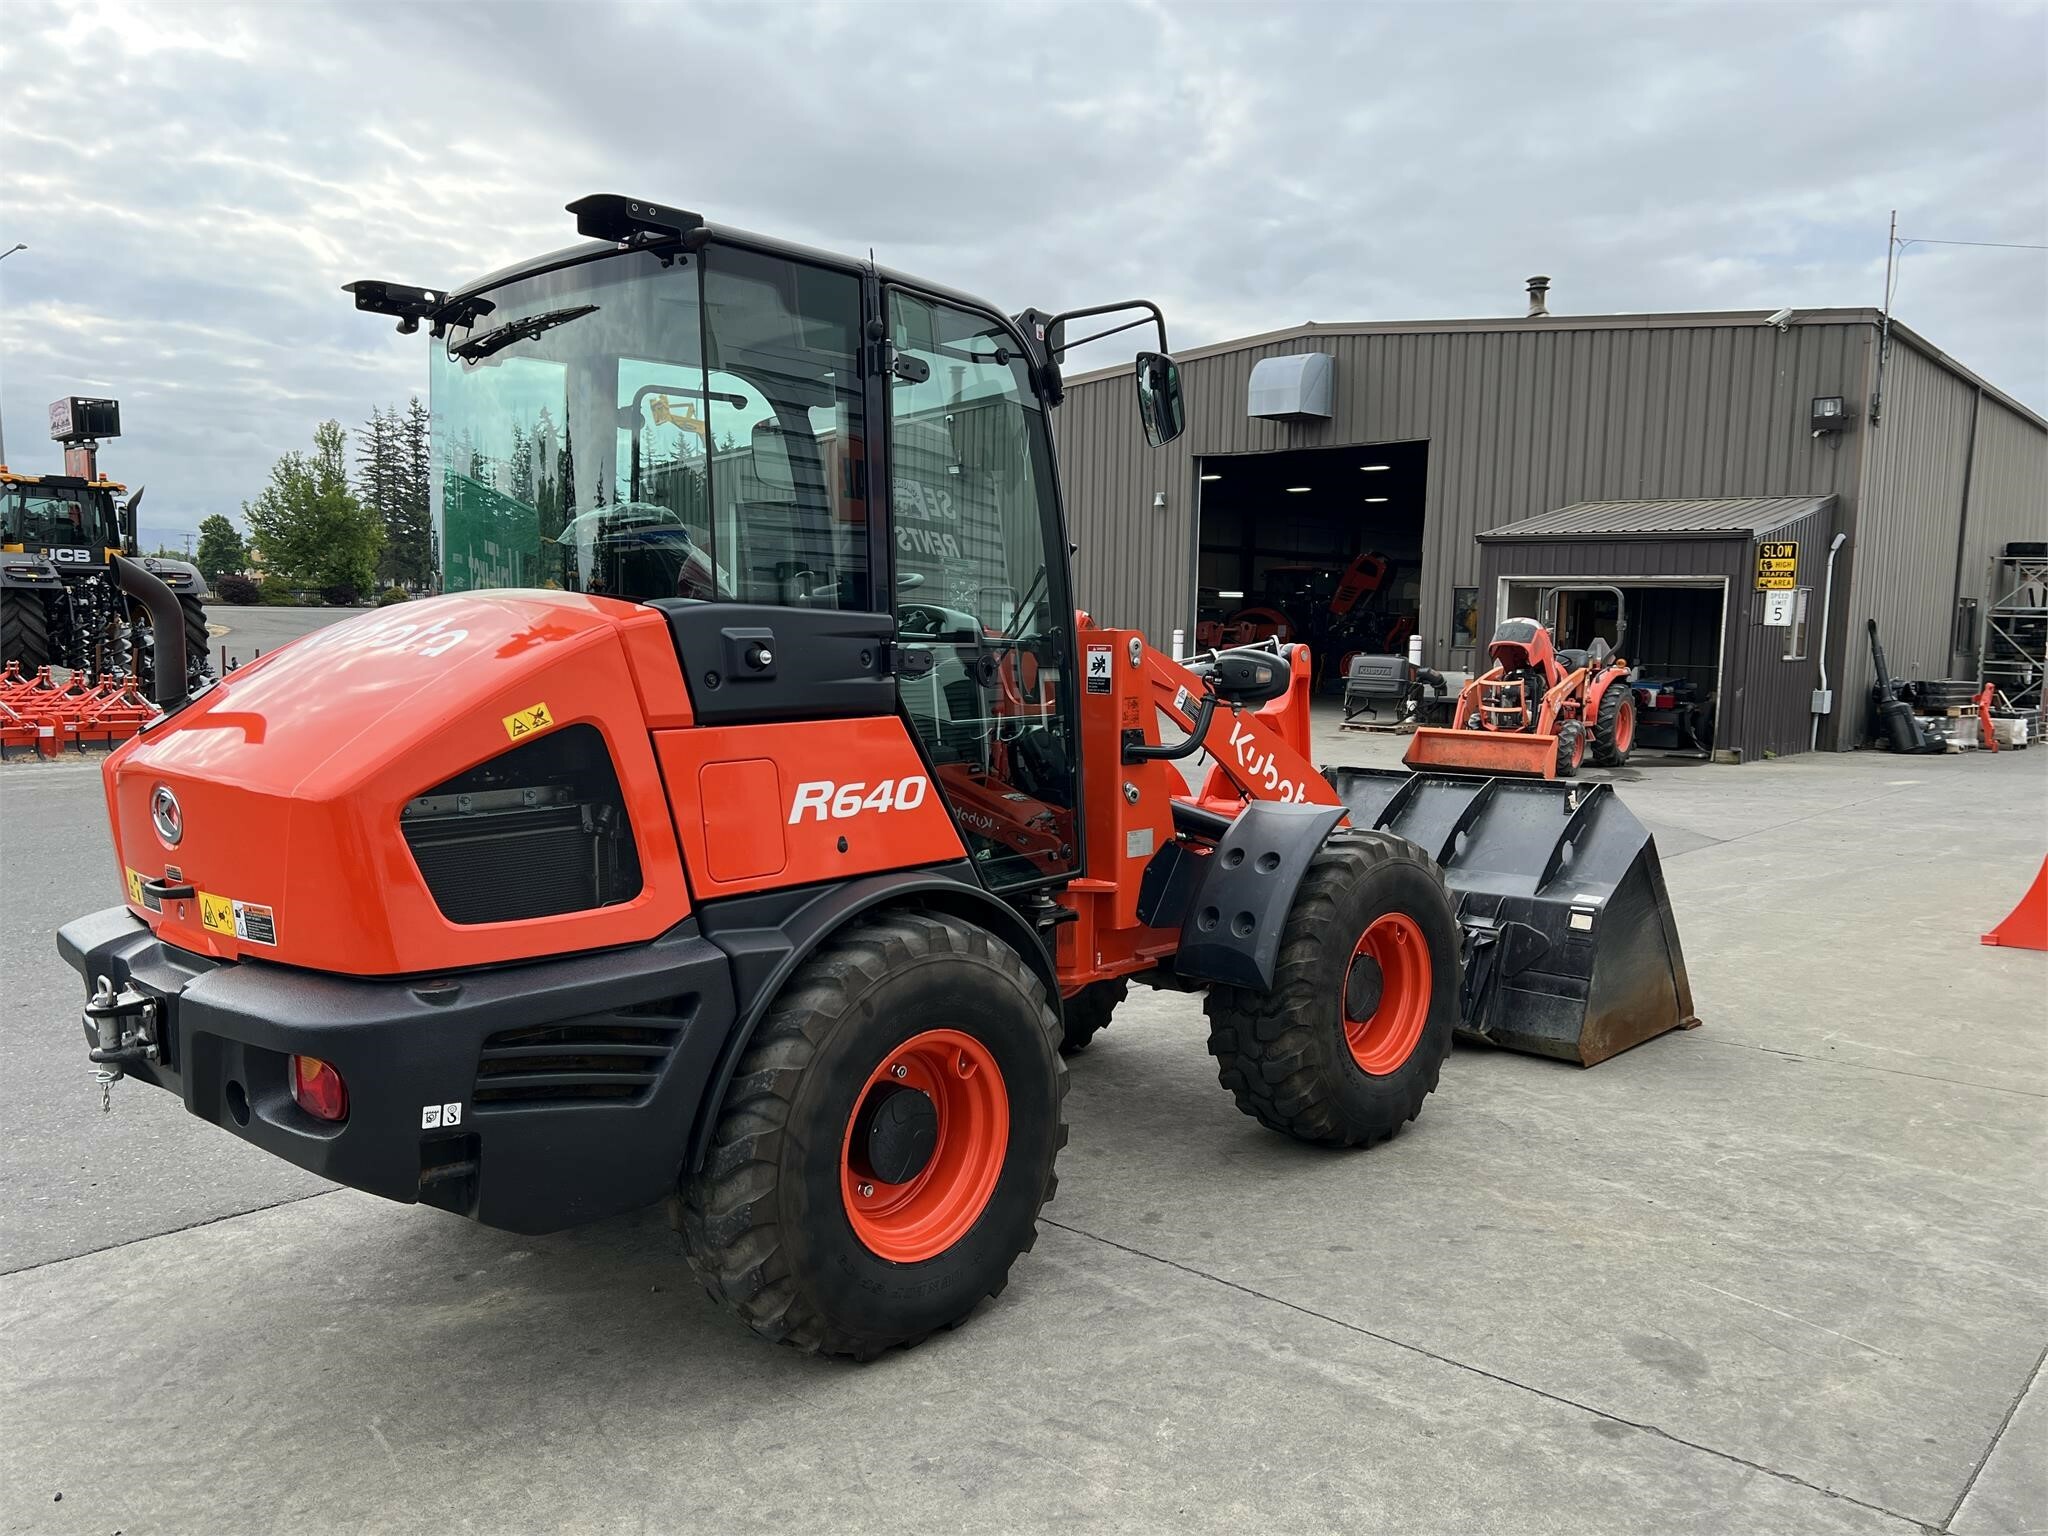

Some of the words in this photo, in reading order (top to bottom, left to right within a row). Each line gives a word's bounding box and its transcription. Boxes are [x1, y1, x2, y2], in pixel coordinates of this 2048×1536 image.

[48, 548, 91, 562] JCB
[1763, 545, 1793, 558] SLOW
[1774, 607, 1782, 621] 5
[1229, 721, 1314, 804] Kubot
[788, 775, 927, 825] R640
